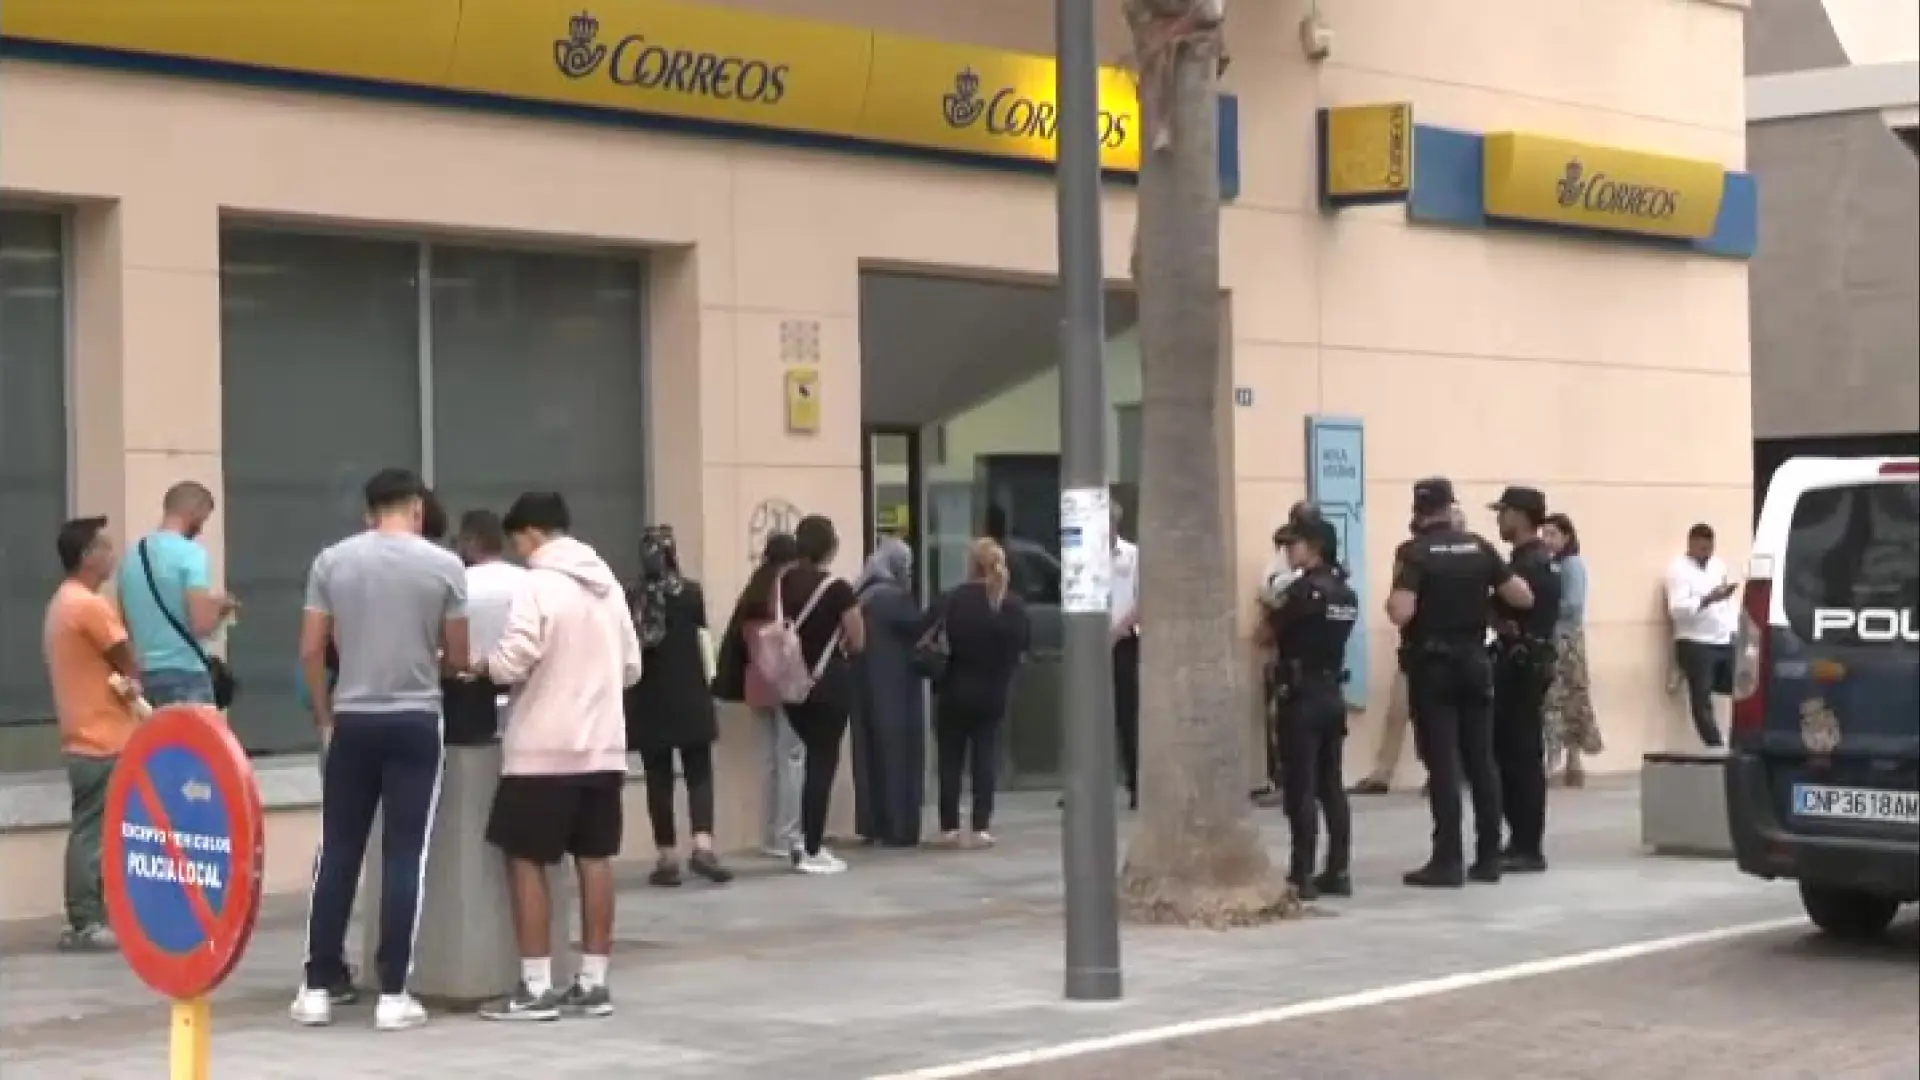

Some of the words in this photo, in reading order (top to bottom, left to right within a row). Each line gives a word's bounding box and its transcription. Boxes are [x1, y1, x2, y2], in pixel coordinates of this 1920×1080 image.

[609, 34, 789, 104] CORREOS
[986, 87, 1131, 148] COROS
[1584, 172, 1681, 218] CORREOS
[178, 858, 222, 888] LOCAL
